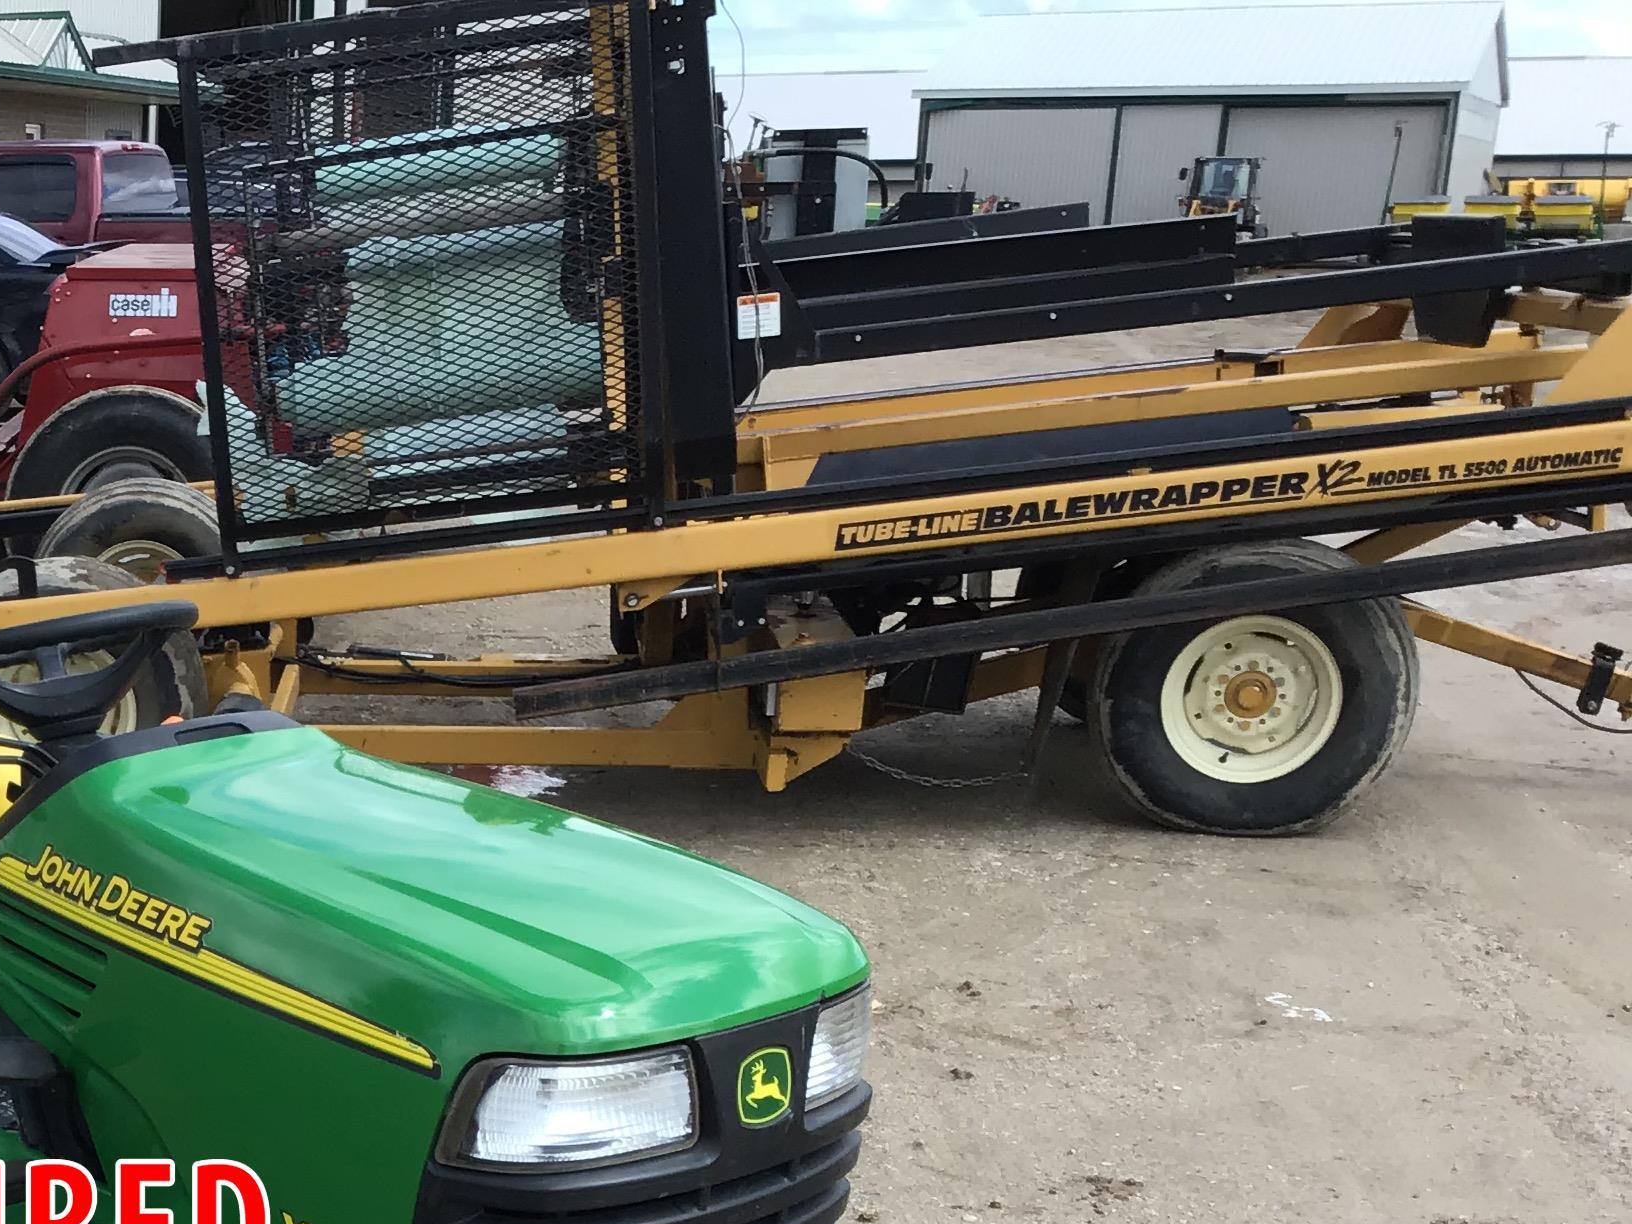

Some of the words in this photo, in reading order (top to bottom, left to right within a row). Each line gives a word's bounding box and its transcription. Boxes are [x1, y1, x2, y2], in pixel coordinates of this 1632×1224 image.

[839, 511, 981, 546] TUBE-LINE
[983, 471, 1310, 529] BALEWRAPPER
[1304, 458, 1366, 501] X2
[1366, 466, 1432, 488] MODEL
[1438, 463, 1457, 481] TL
[1462, 458, 1508, 479] 5500
[1513, 446, 1624, 473] AUTOMATIC
[25, 844, 102, 903] JOHN
[98, 874, 212, 950] DEERE
